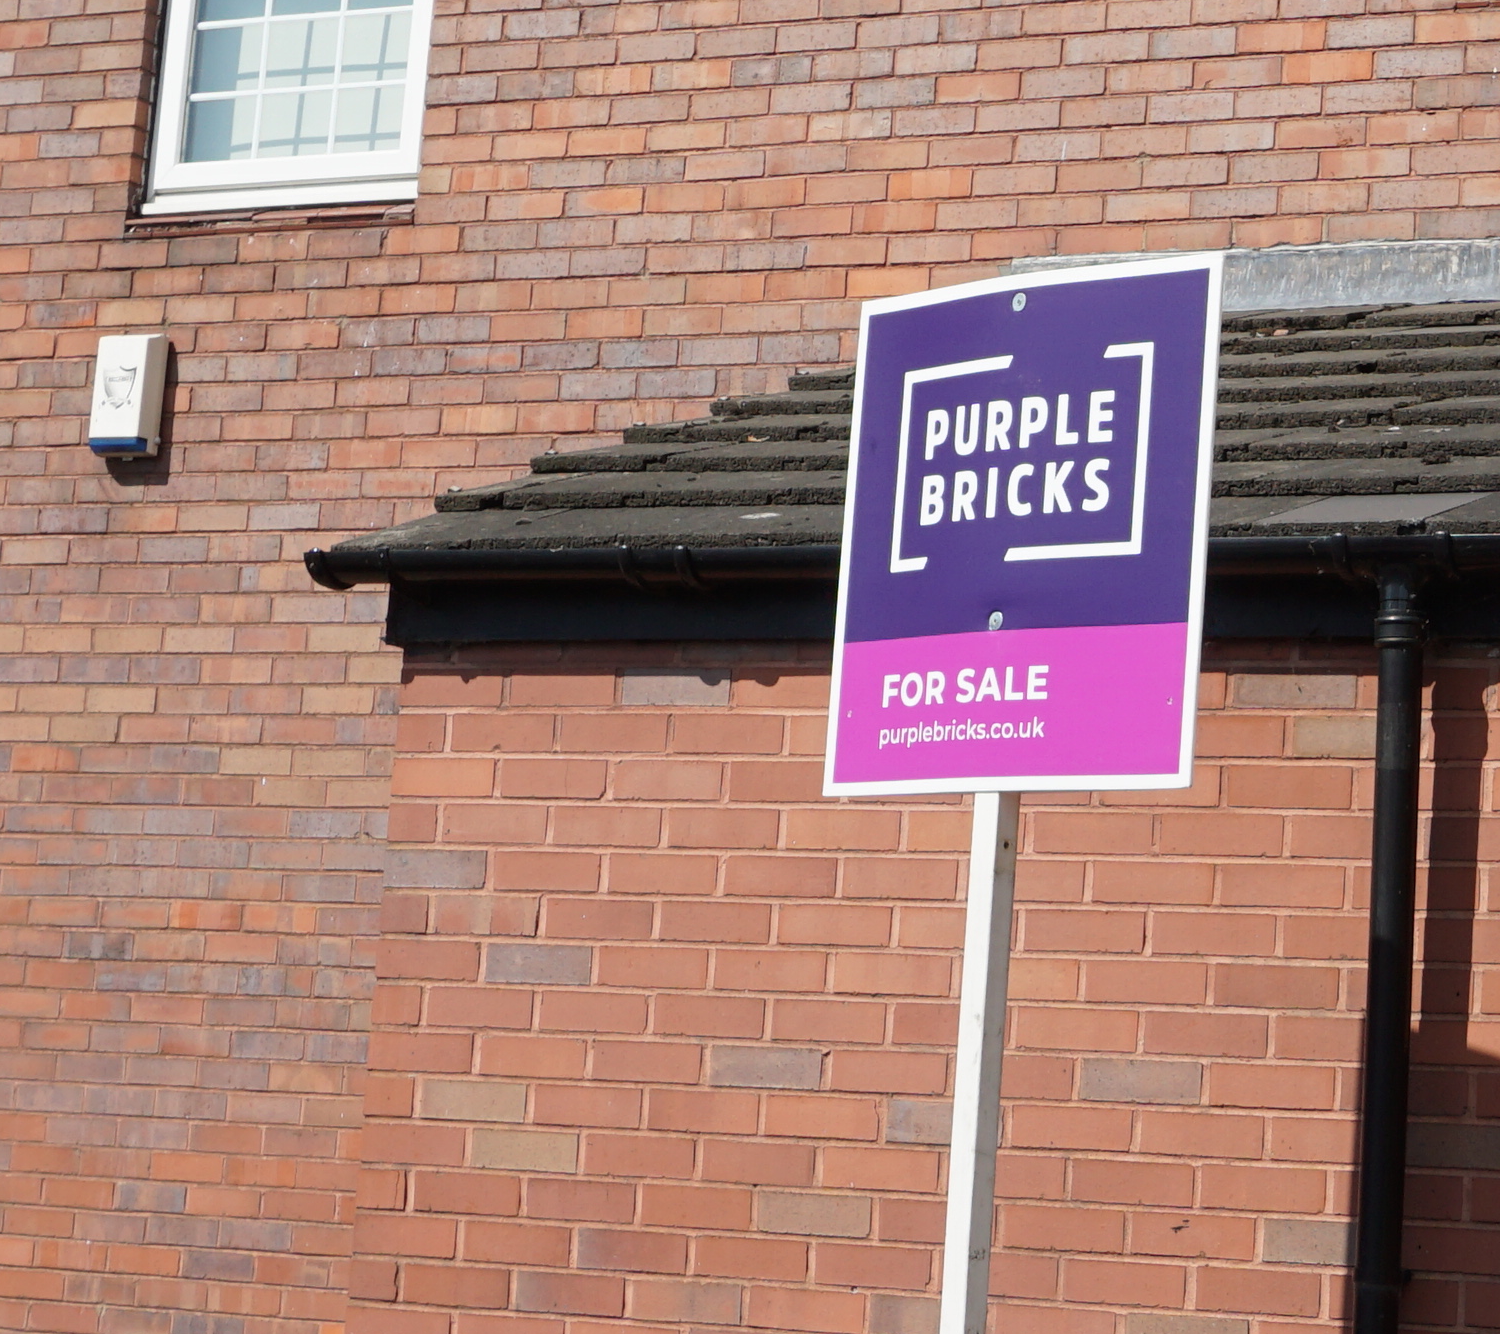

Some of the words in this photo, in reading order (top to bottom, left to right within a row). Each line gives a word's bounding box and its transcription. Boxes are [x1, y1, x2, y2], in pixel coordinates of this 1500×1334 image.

[925, 390, 1115, 460] PURPLE
[920, 459, 1110, 526] BRICKS
[882, 671, 946, 708] FOR
[955, 665, 1049, 704] SALE
[878, 716, 1045, 750] purplebricks.co.uk
